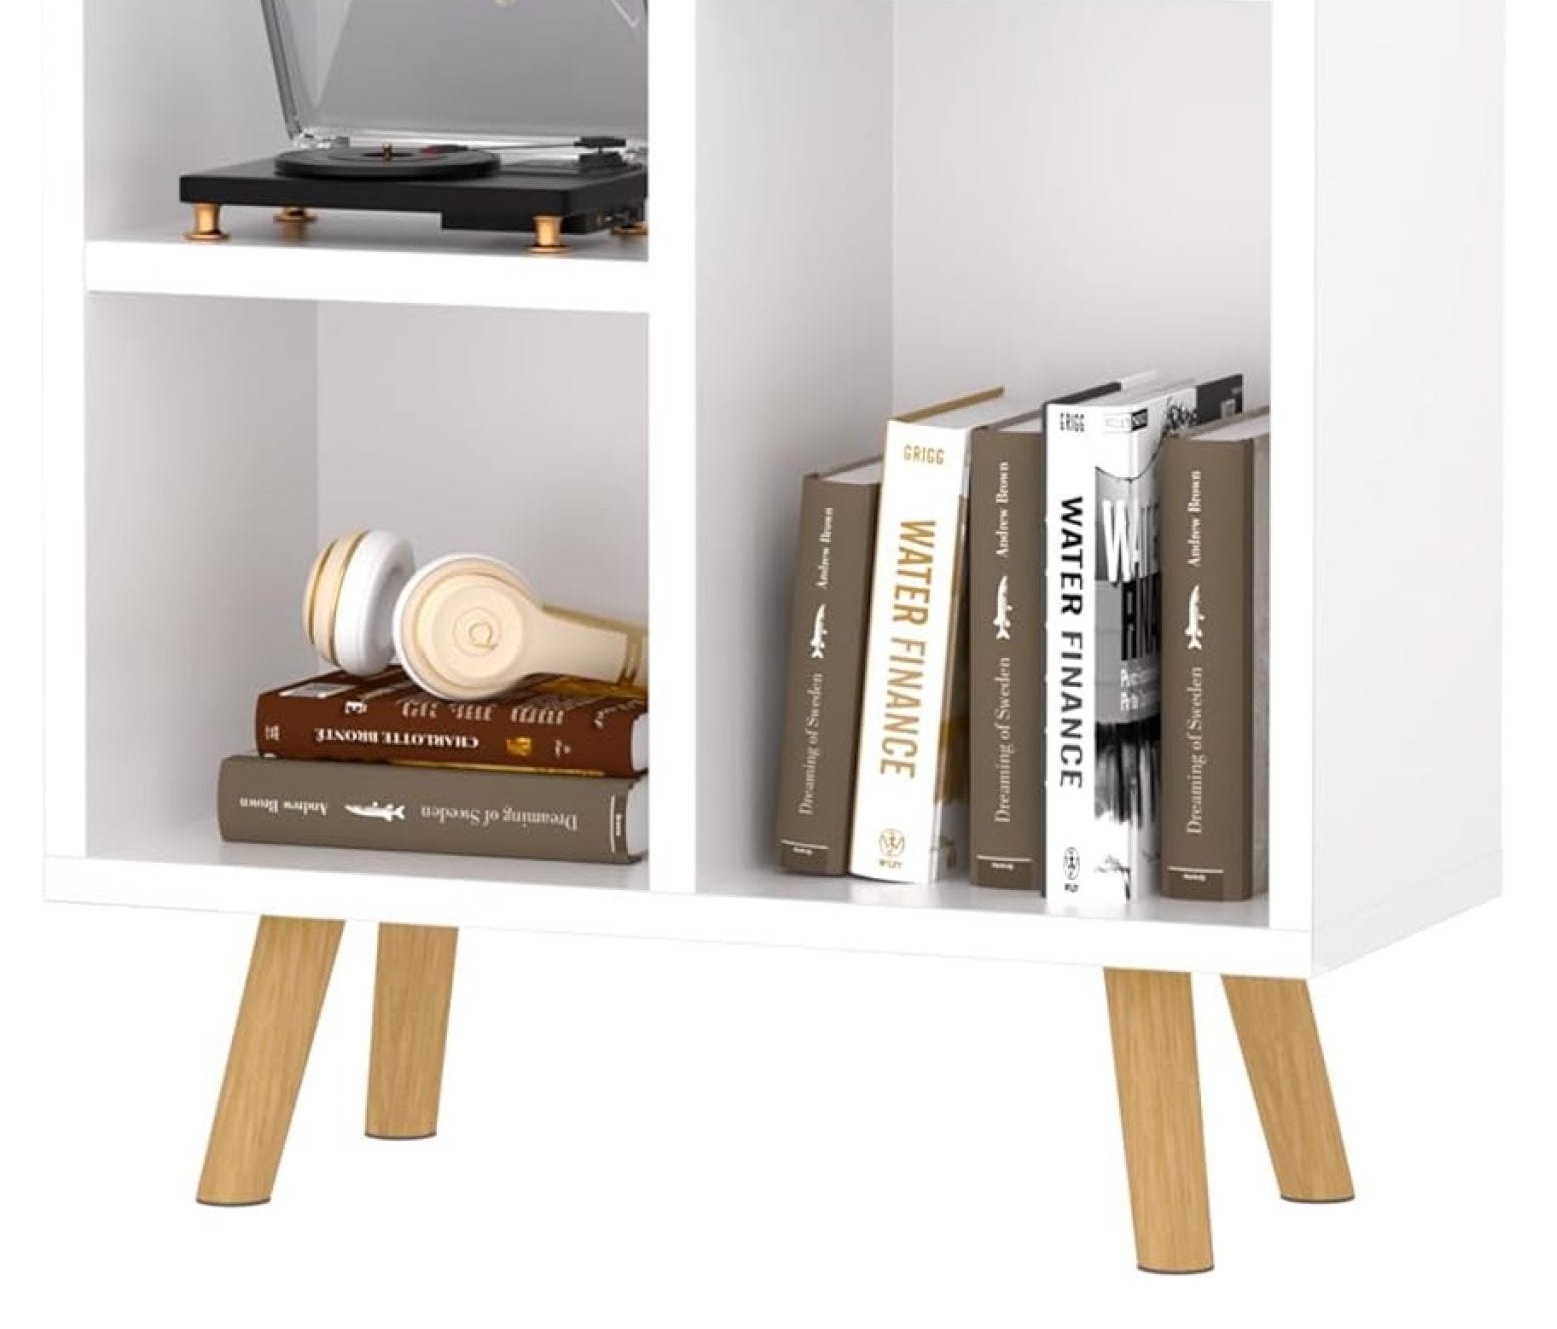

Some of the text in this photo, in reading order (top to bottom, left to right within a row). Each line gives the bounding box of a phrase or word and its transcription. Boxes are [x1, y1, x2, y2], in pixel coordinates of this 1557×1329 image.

[904, 444, 945, 466] GRIGG
[815, 506, 833, 590] Andrew Brown
[996, 461, 1010, 559] Andrew Brown
[1186, 470, 1201, 568] Andrew Brown
[880, 519, 936, 779] WATER FINANCE
[1060, 496, 1083, 788] WATER FINANCE
[381, 731, 480, 749] CHARLOTTE
[798, 672, 823, 816] Dreaming of Sweden
[994, 656, 1014, 823] Dreaming of Sweden
[1186, 667, 1206, 834] Dreaming of Sweden
[239, 796, 329, 817] Andrew Brown
[420, 805, 578, 832] Dreaming of Sweden
